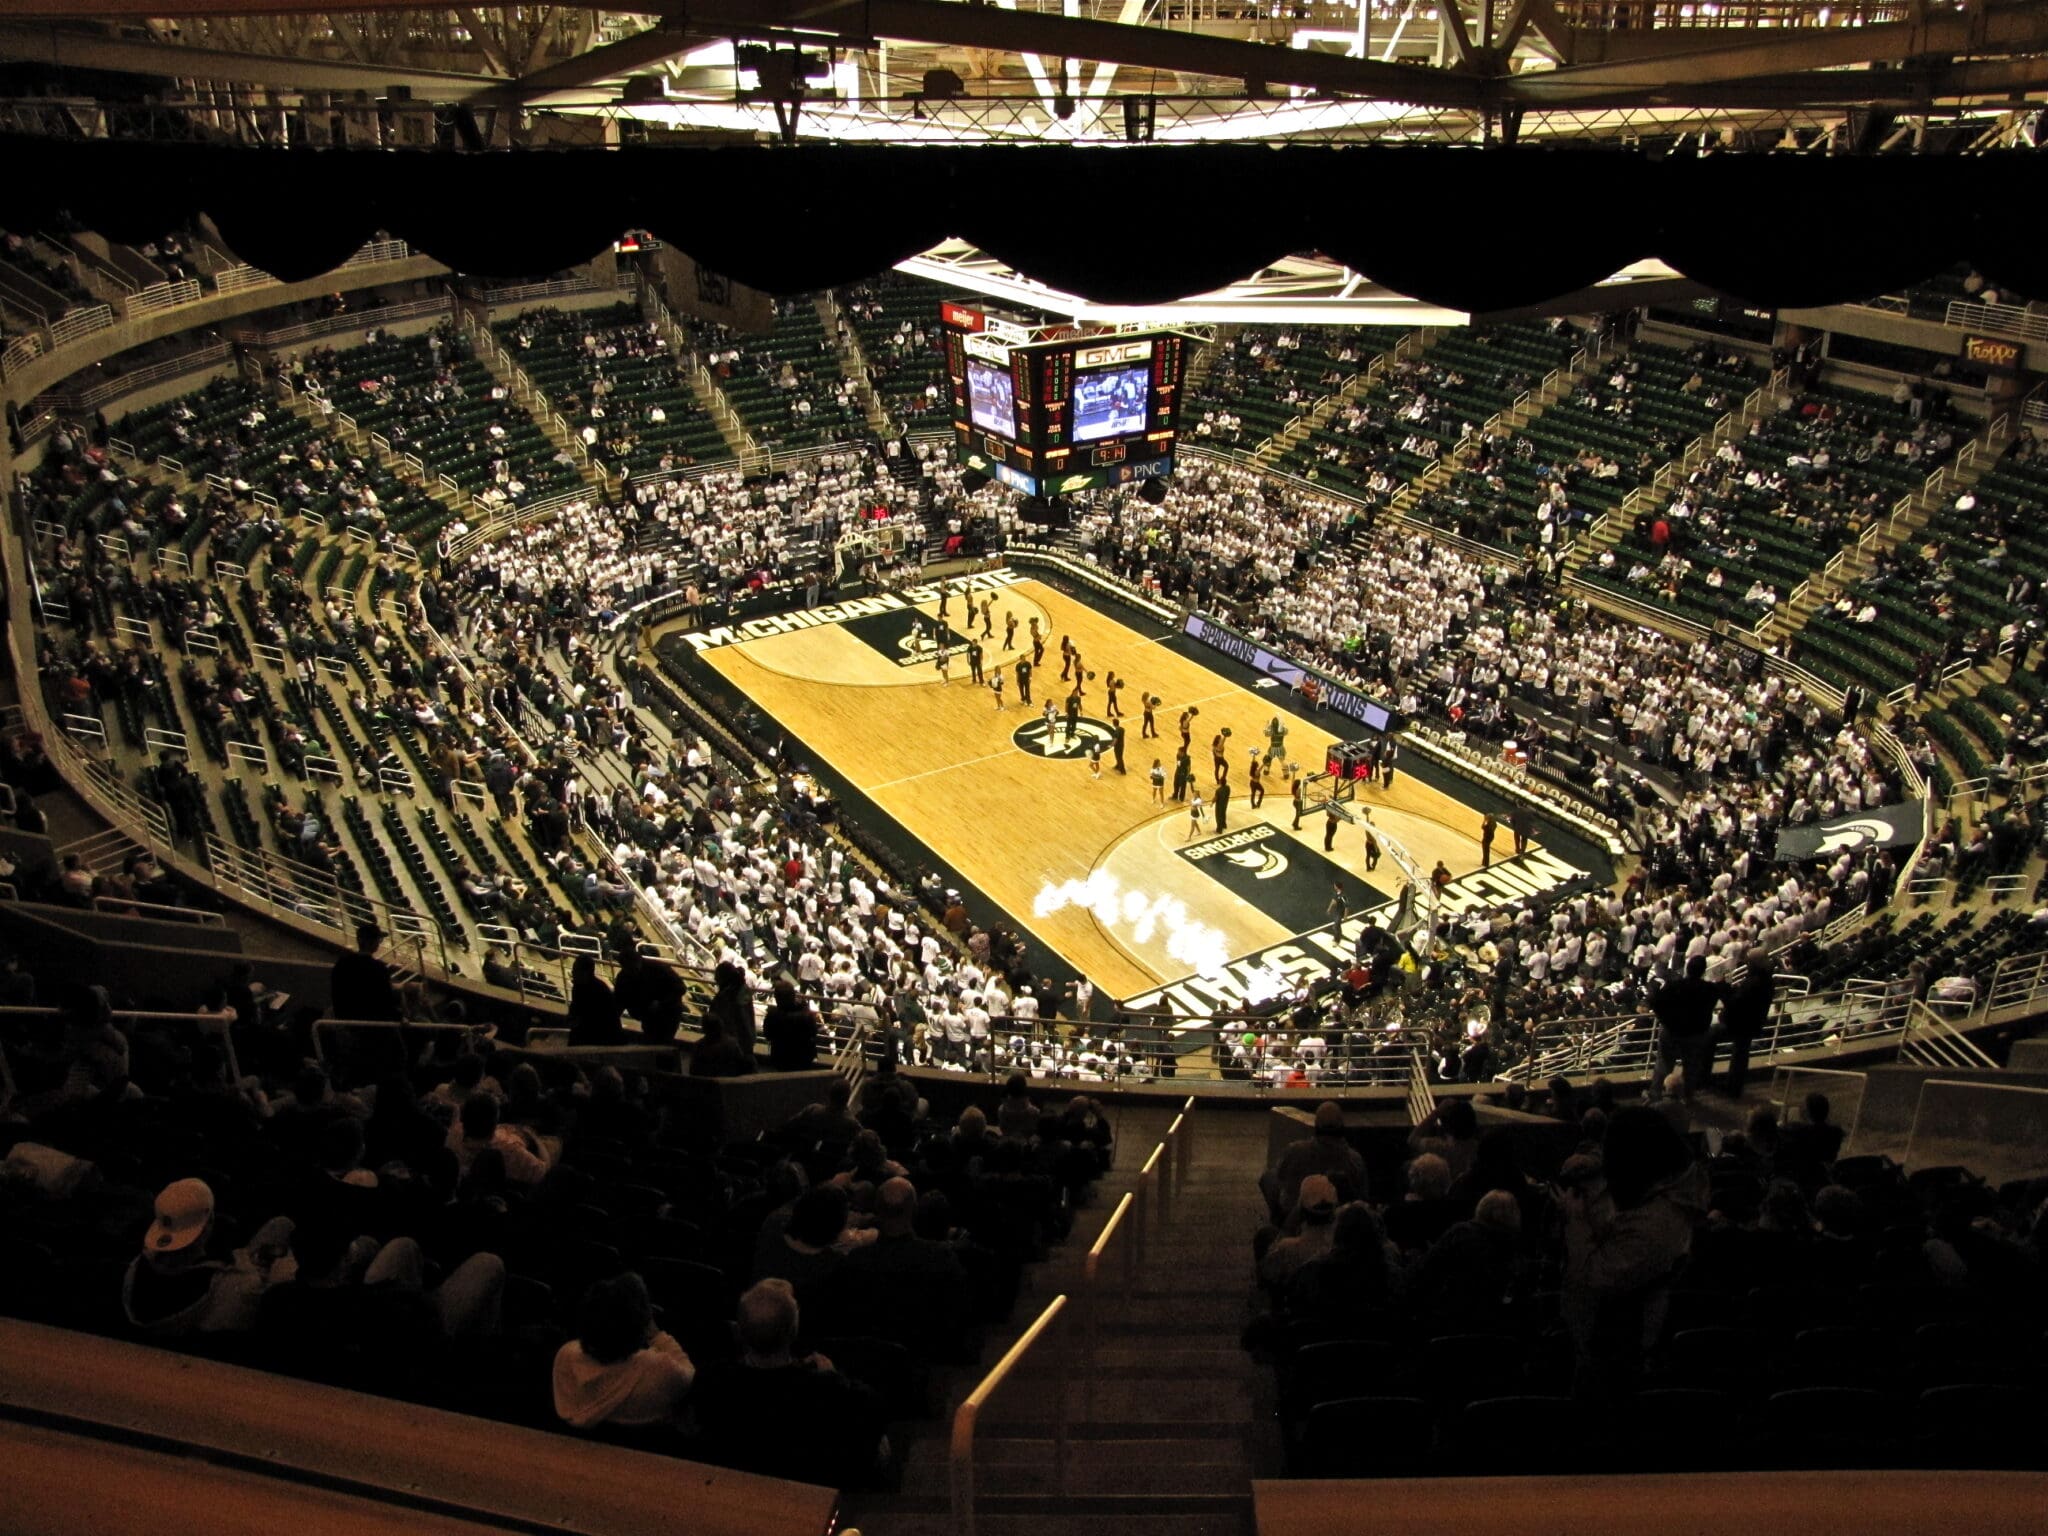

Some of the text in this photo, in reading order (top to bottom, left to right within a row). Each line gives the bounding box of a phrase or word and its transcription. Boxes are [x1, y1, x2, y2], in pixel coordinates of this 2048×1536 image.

[952, 310, 974, 327] meijer
[1085, 344, 1141, 364] GMC
[1966, 336, 2018, 365] Troppo
[1011, 469, 1030, 490] PNC
[1133, 462, 1161, 478] PNC
[1200, 622, 1257, 665] SPARTANS
[1328, 760, 1340, 777] 35
[1354, 764, 1368, 778] 35
[1184, 825, 1276, 860] SPARTANS
